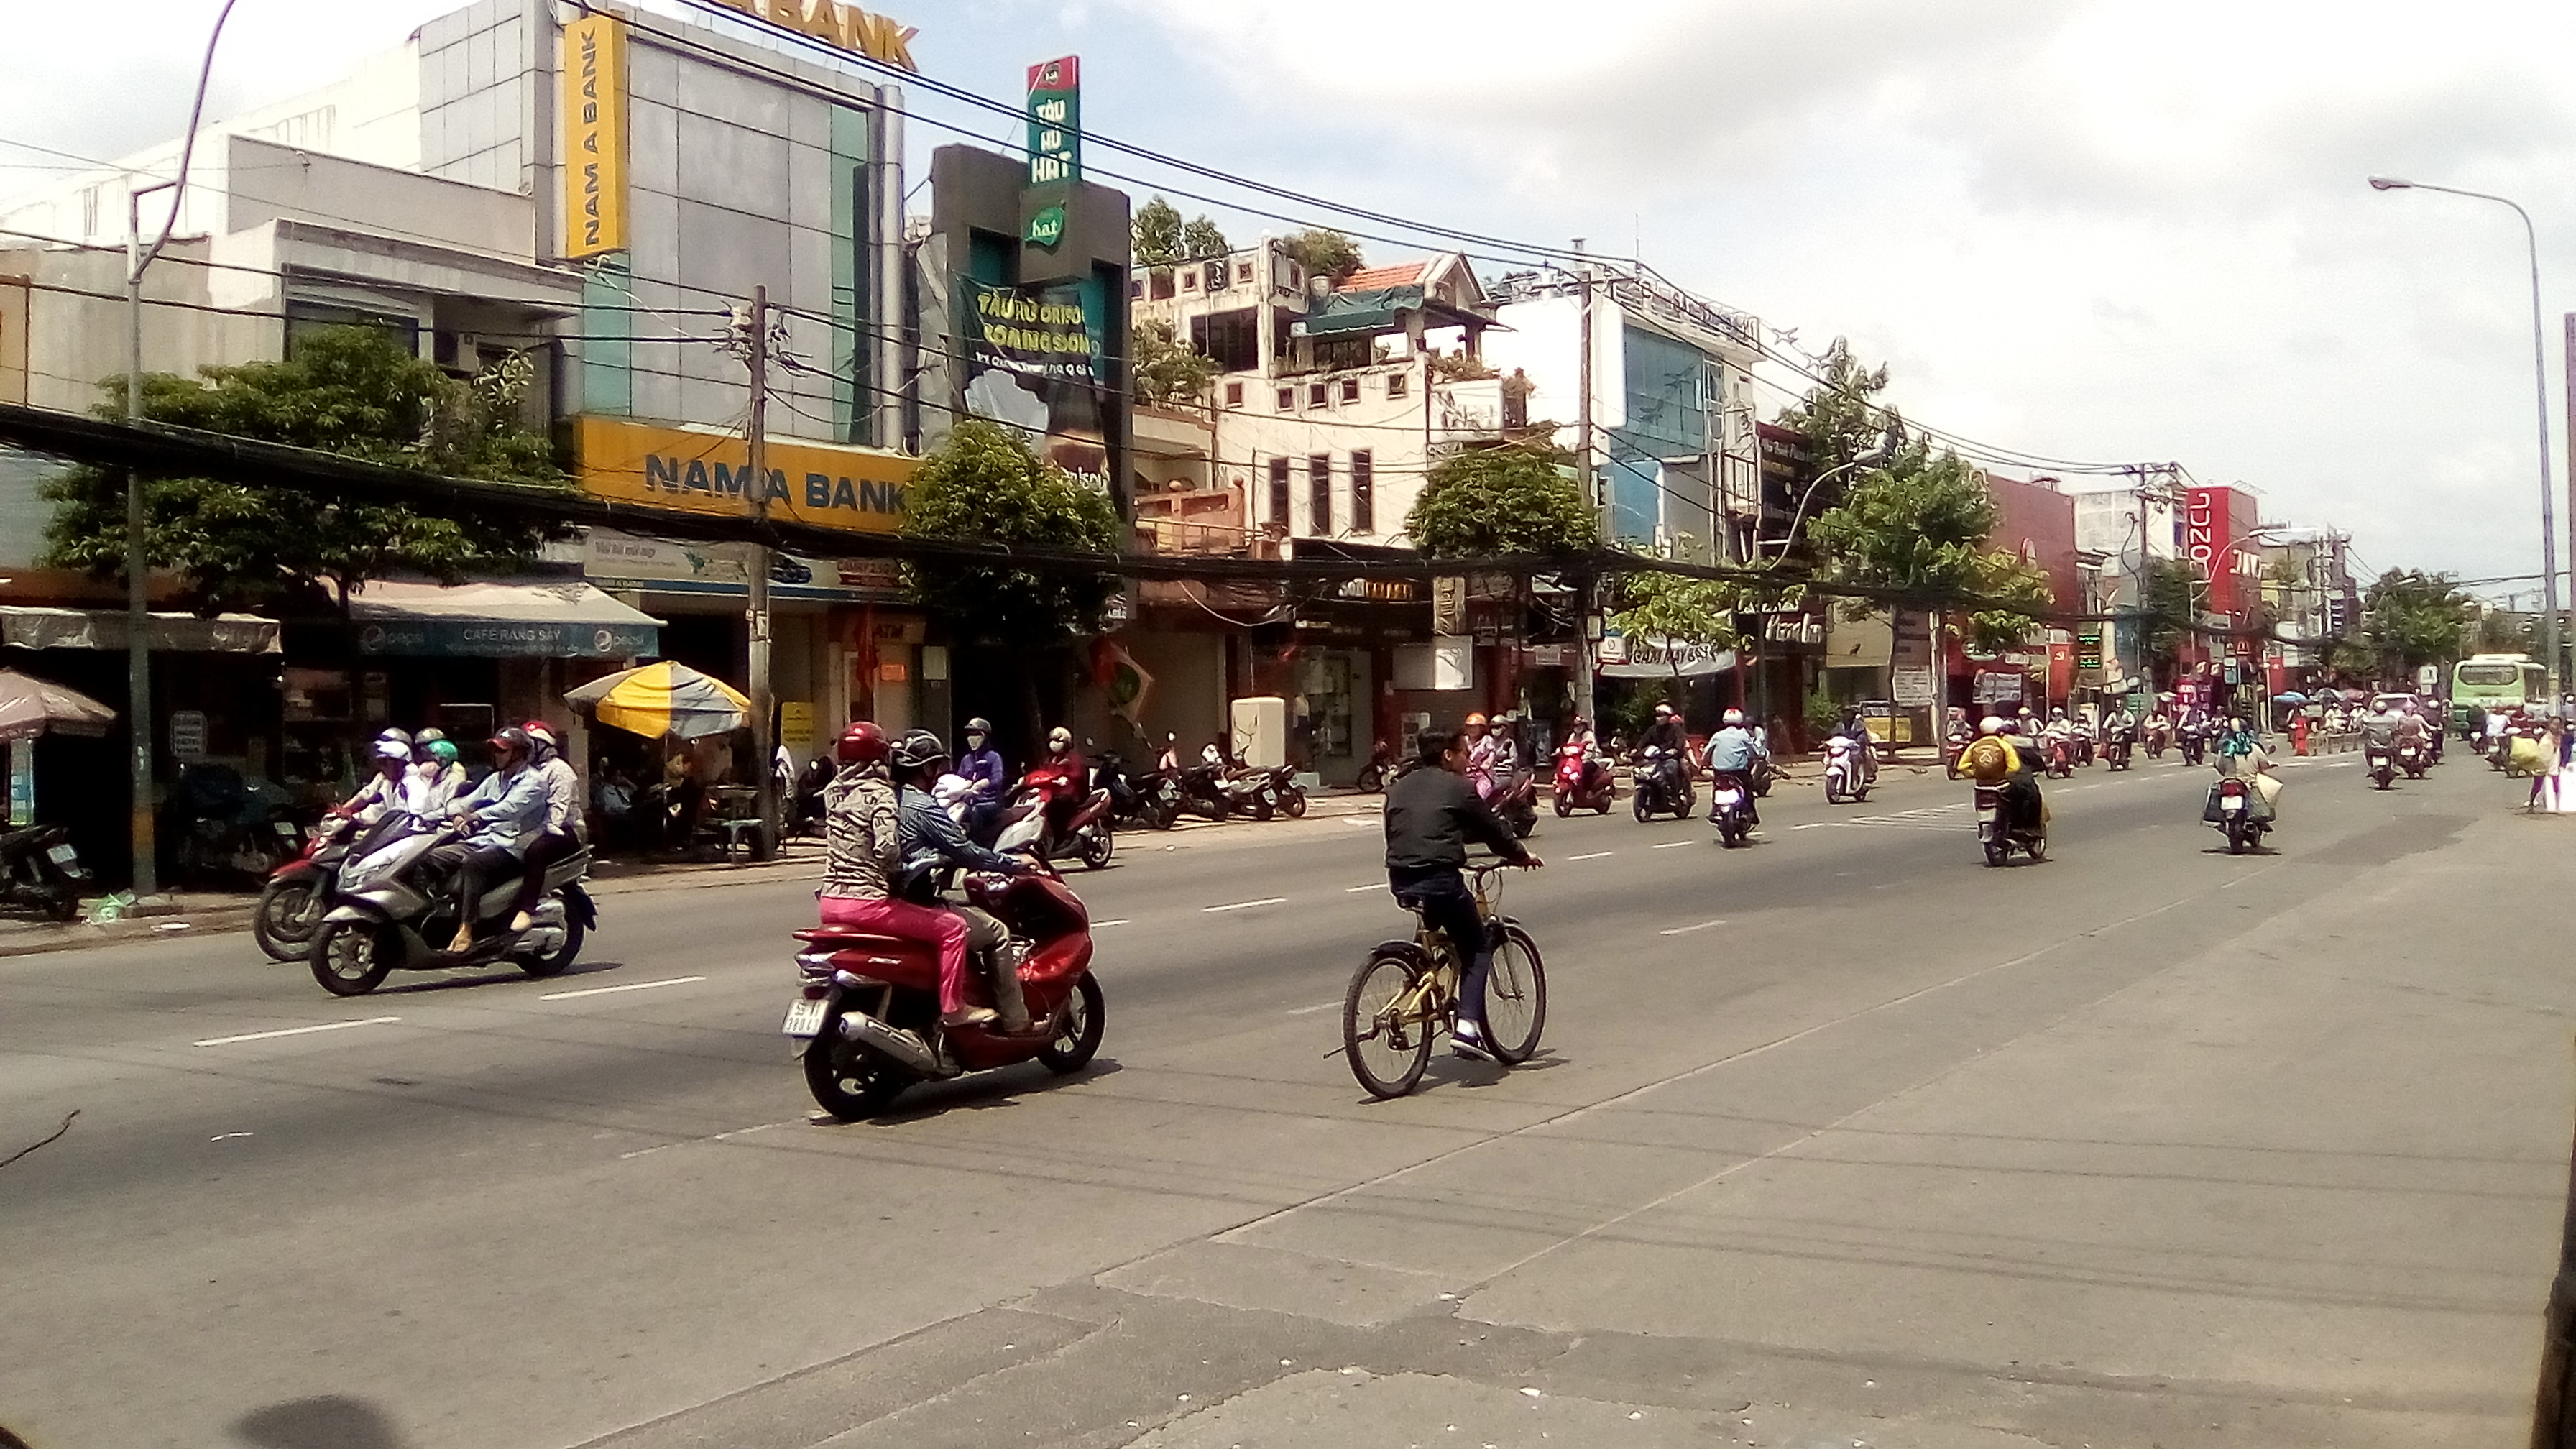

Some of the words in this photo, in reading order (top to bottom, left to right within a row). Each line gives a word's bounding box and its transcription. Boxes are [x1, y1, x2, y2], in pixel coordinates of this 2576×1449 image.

[581, 26, 597, 124] BANK
[584, 130, 599, 154] A
[584, 162, 600, 246] NAM
[1031, 218, 1059, 237] hat
[645, 454, 752, 501] NAM
[765, 468, 793, 506] A
[805, 472, 908, 515] BANK
